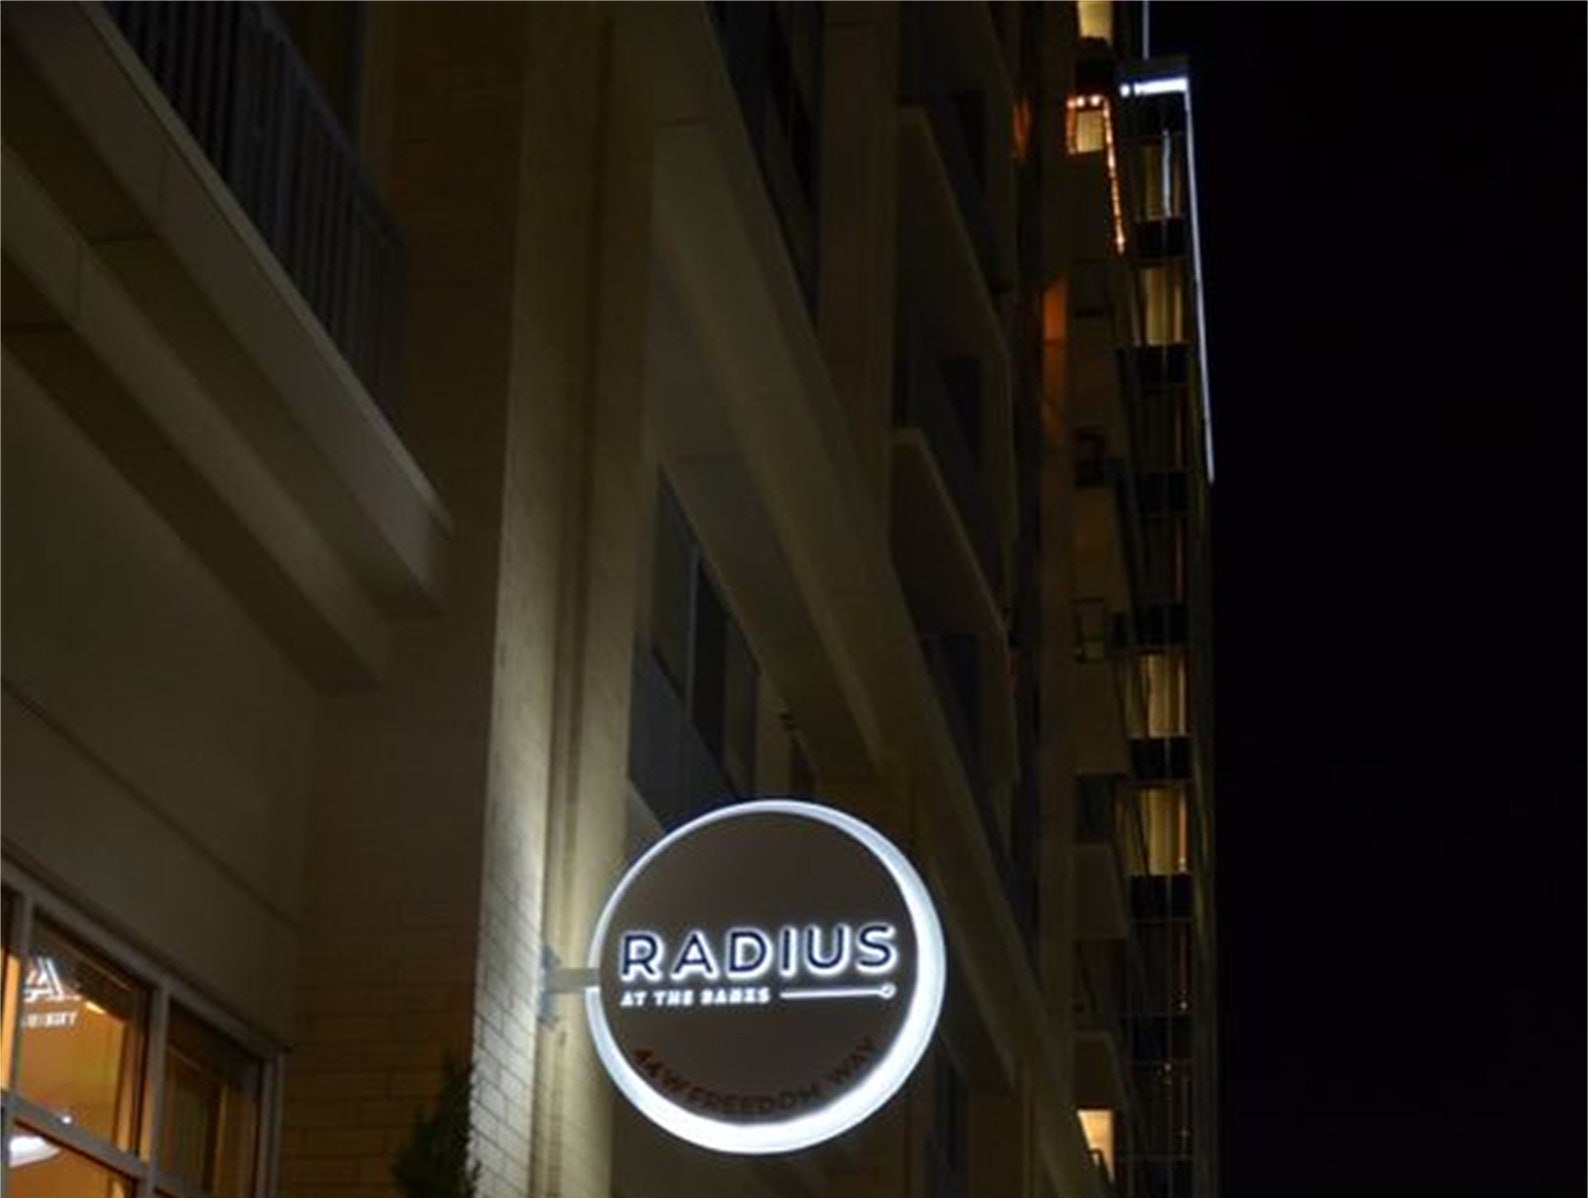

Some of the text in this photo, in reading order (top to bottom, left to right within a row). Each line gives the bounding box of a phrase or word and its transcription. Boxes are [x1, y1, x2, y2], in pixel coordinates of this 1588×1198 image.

[620, 924, 898, 981] RADIUS
[620, 987, 770, 1007] AT THE BANKS
[685, 1082, 822, 1113] FREEDOM
[826, 1036, 876, 1083] WAY
